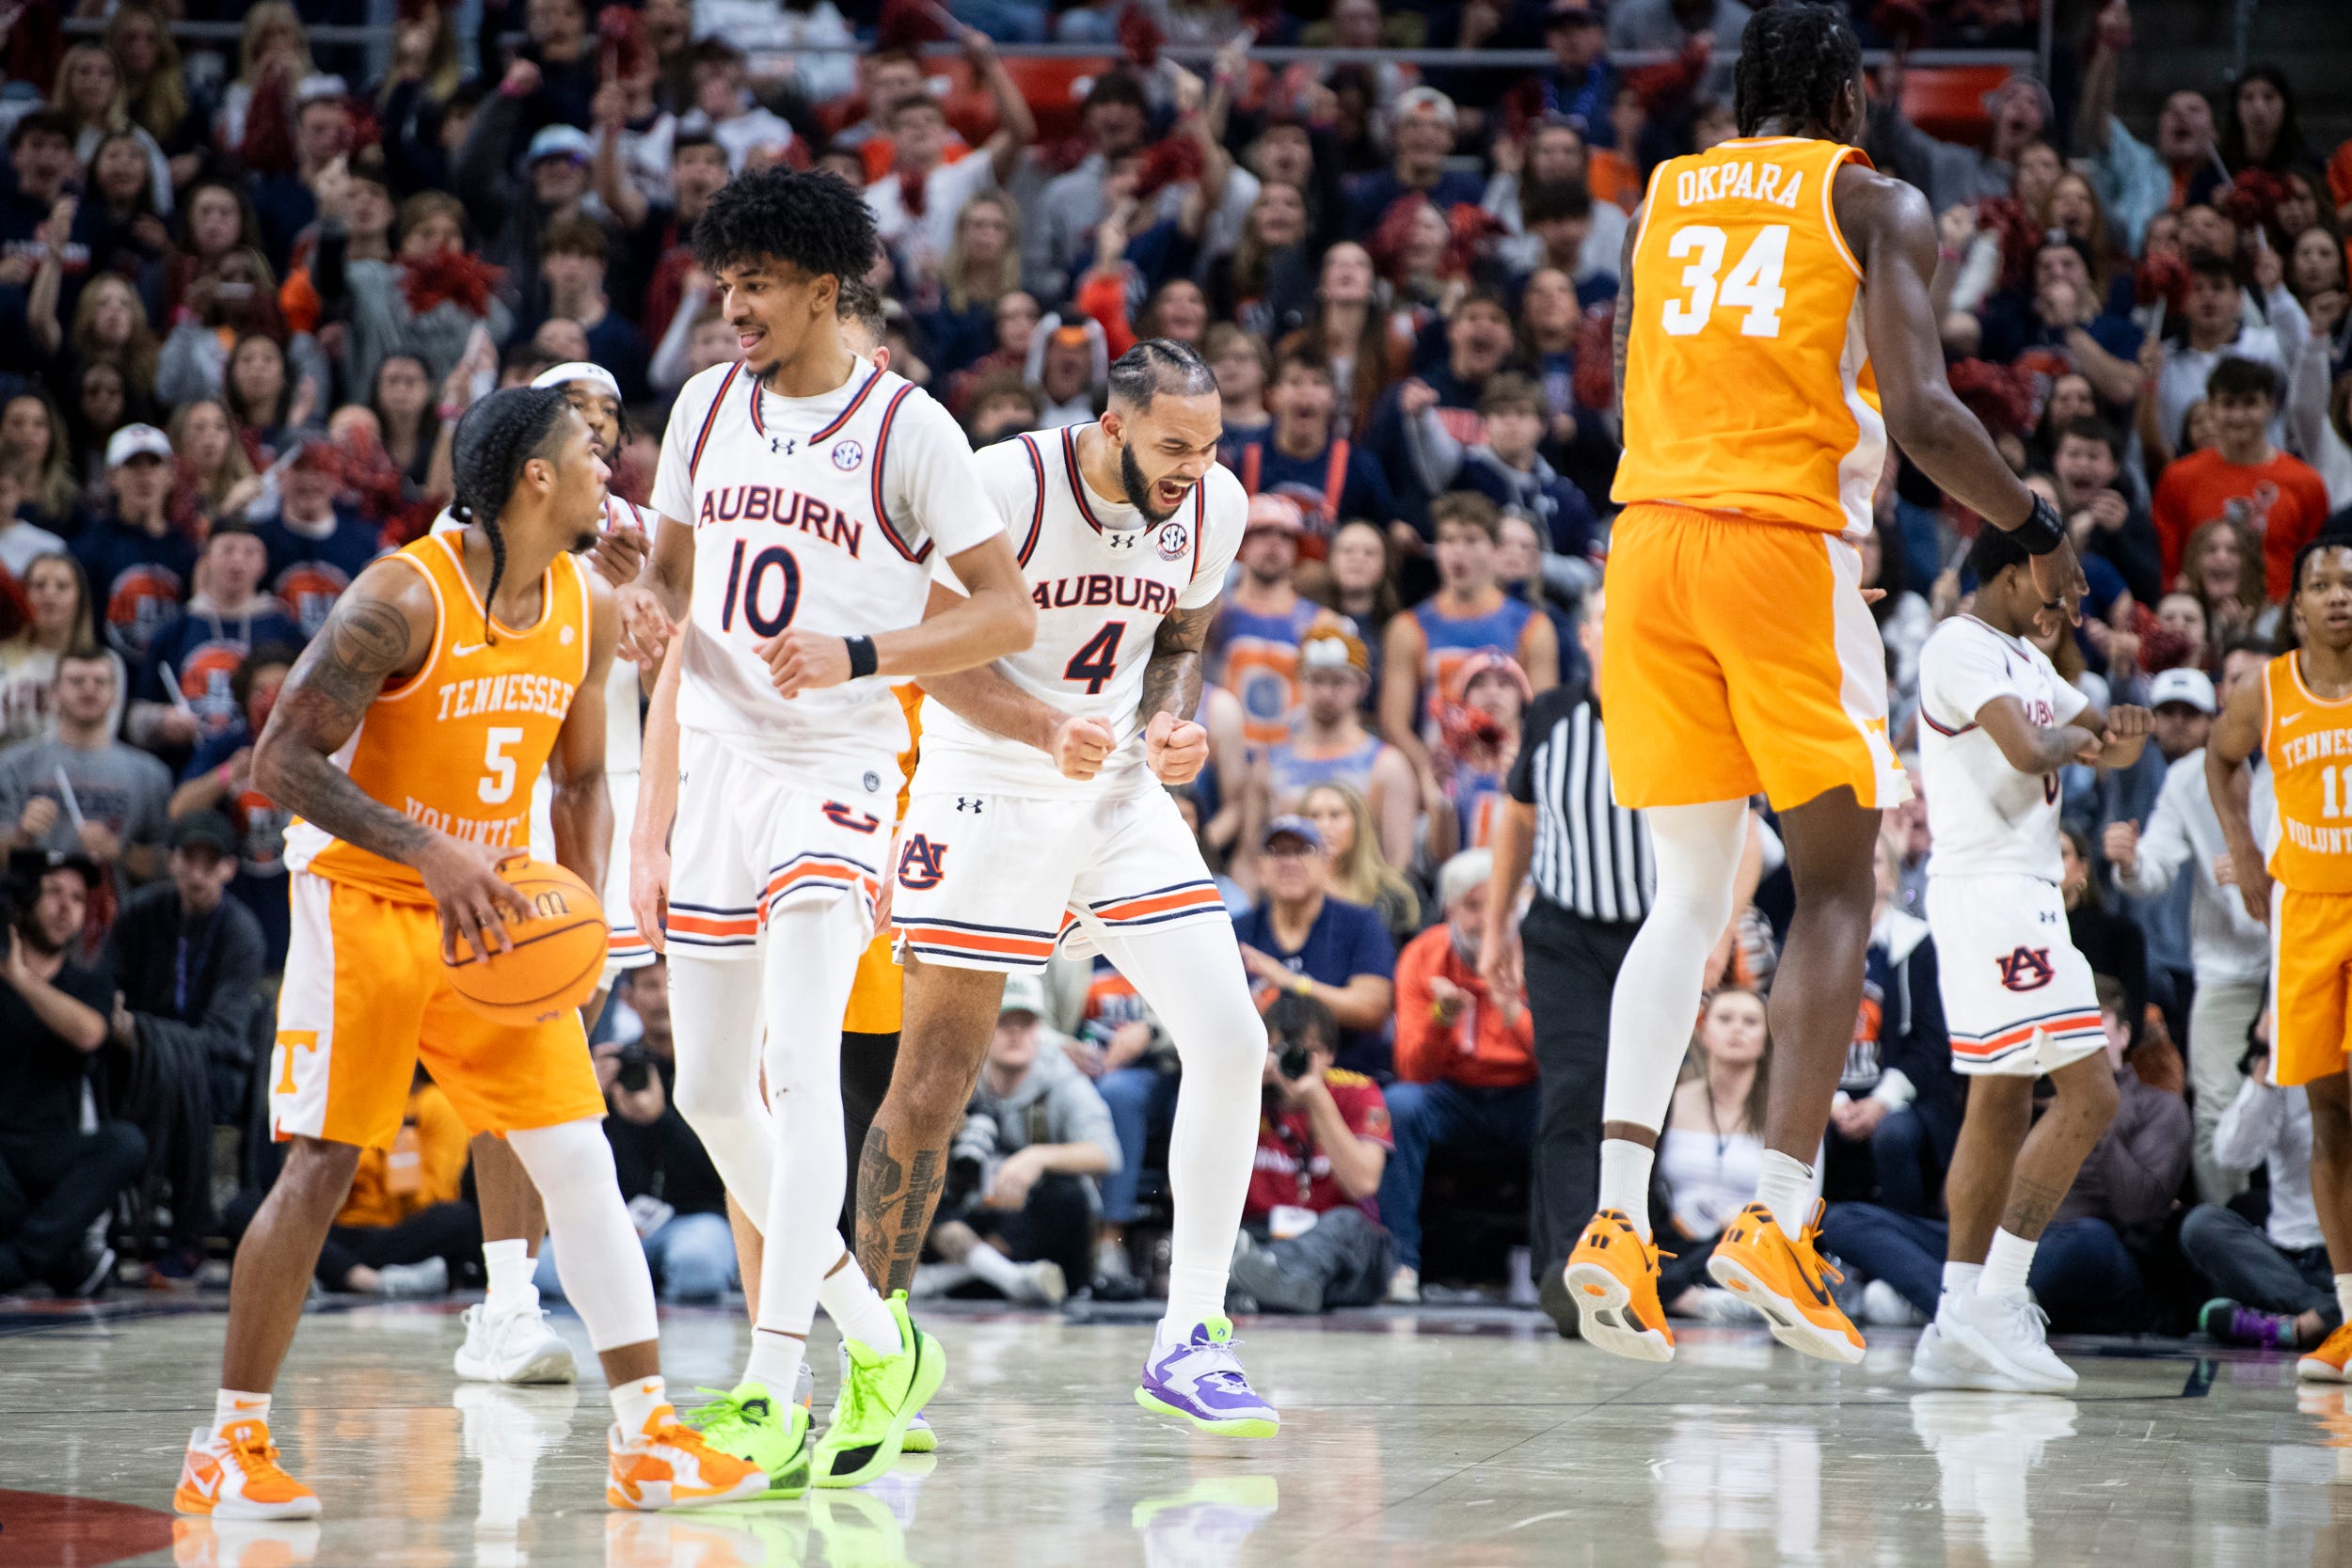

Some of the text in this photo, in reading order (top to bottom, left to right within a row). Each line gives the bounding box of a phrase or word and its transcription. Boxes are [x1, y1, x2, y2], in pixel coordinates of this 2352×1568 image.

[1677, 161, 1804, 209] OKPARA
[1661, 225, 1790, 338] 34
[698, 485, 864, 560] AUBURN
[1161, 524, 1186, 552] SEC
[723, 539, 802, 639] 10
[1063, 621, 1127, 695] 4
[478, 727, 523, 803] 5
[2322, 766, 2352, 817] 11
[277, 1030, 318, 1094] T
